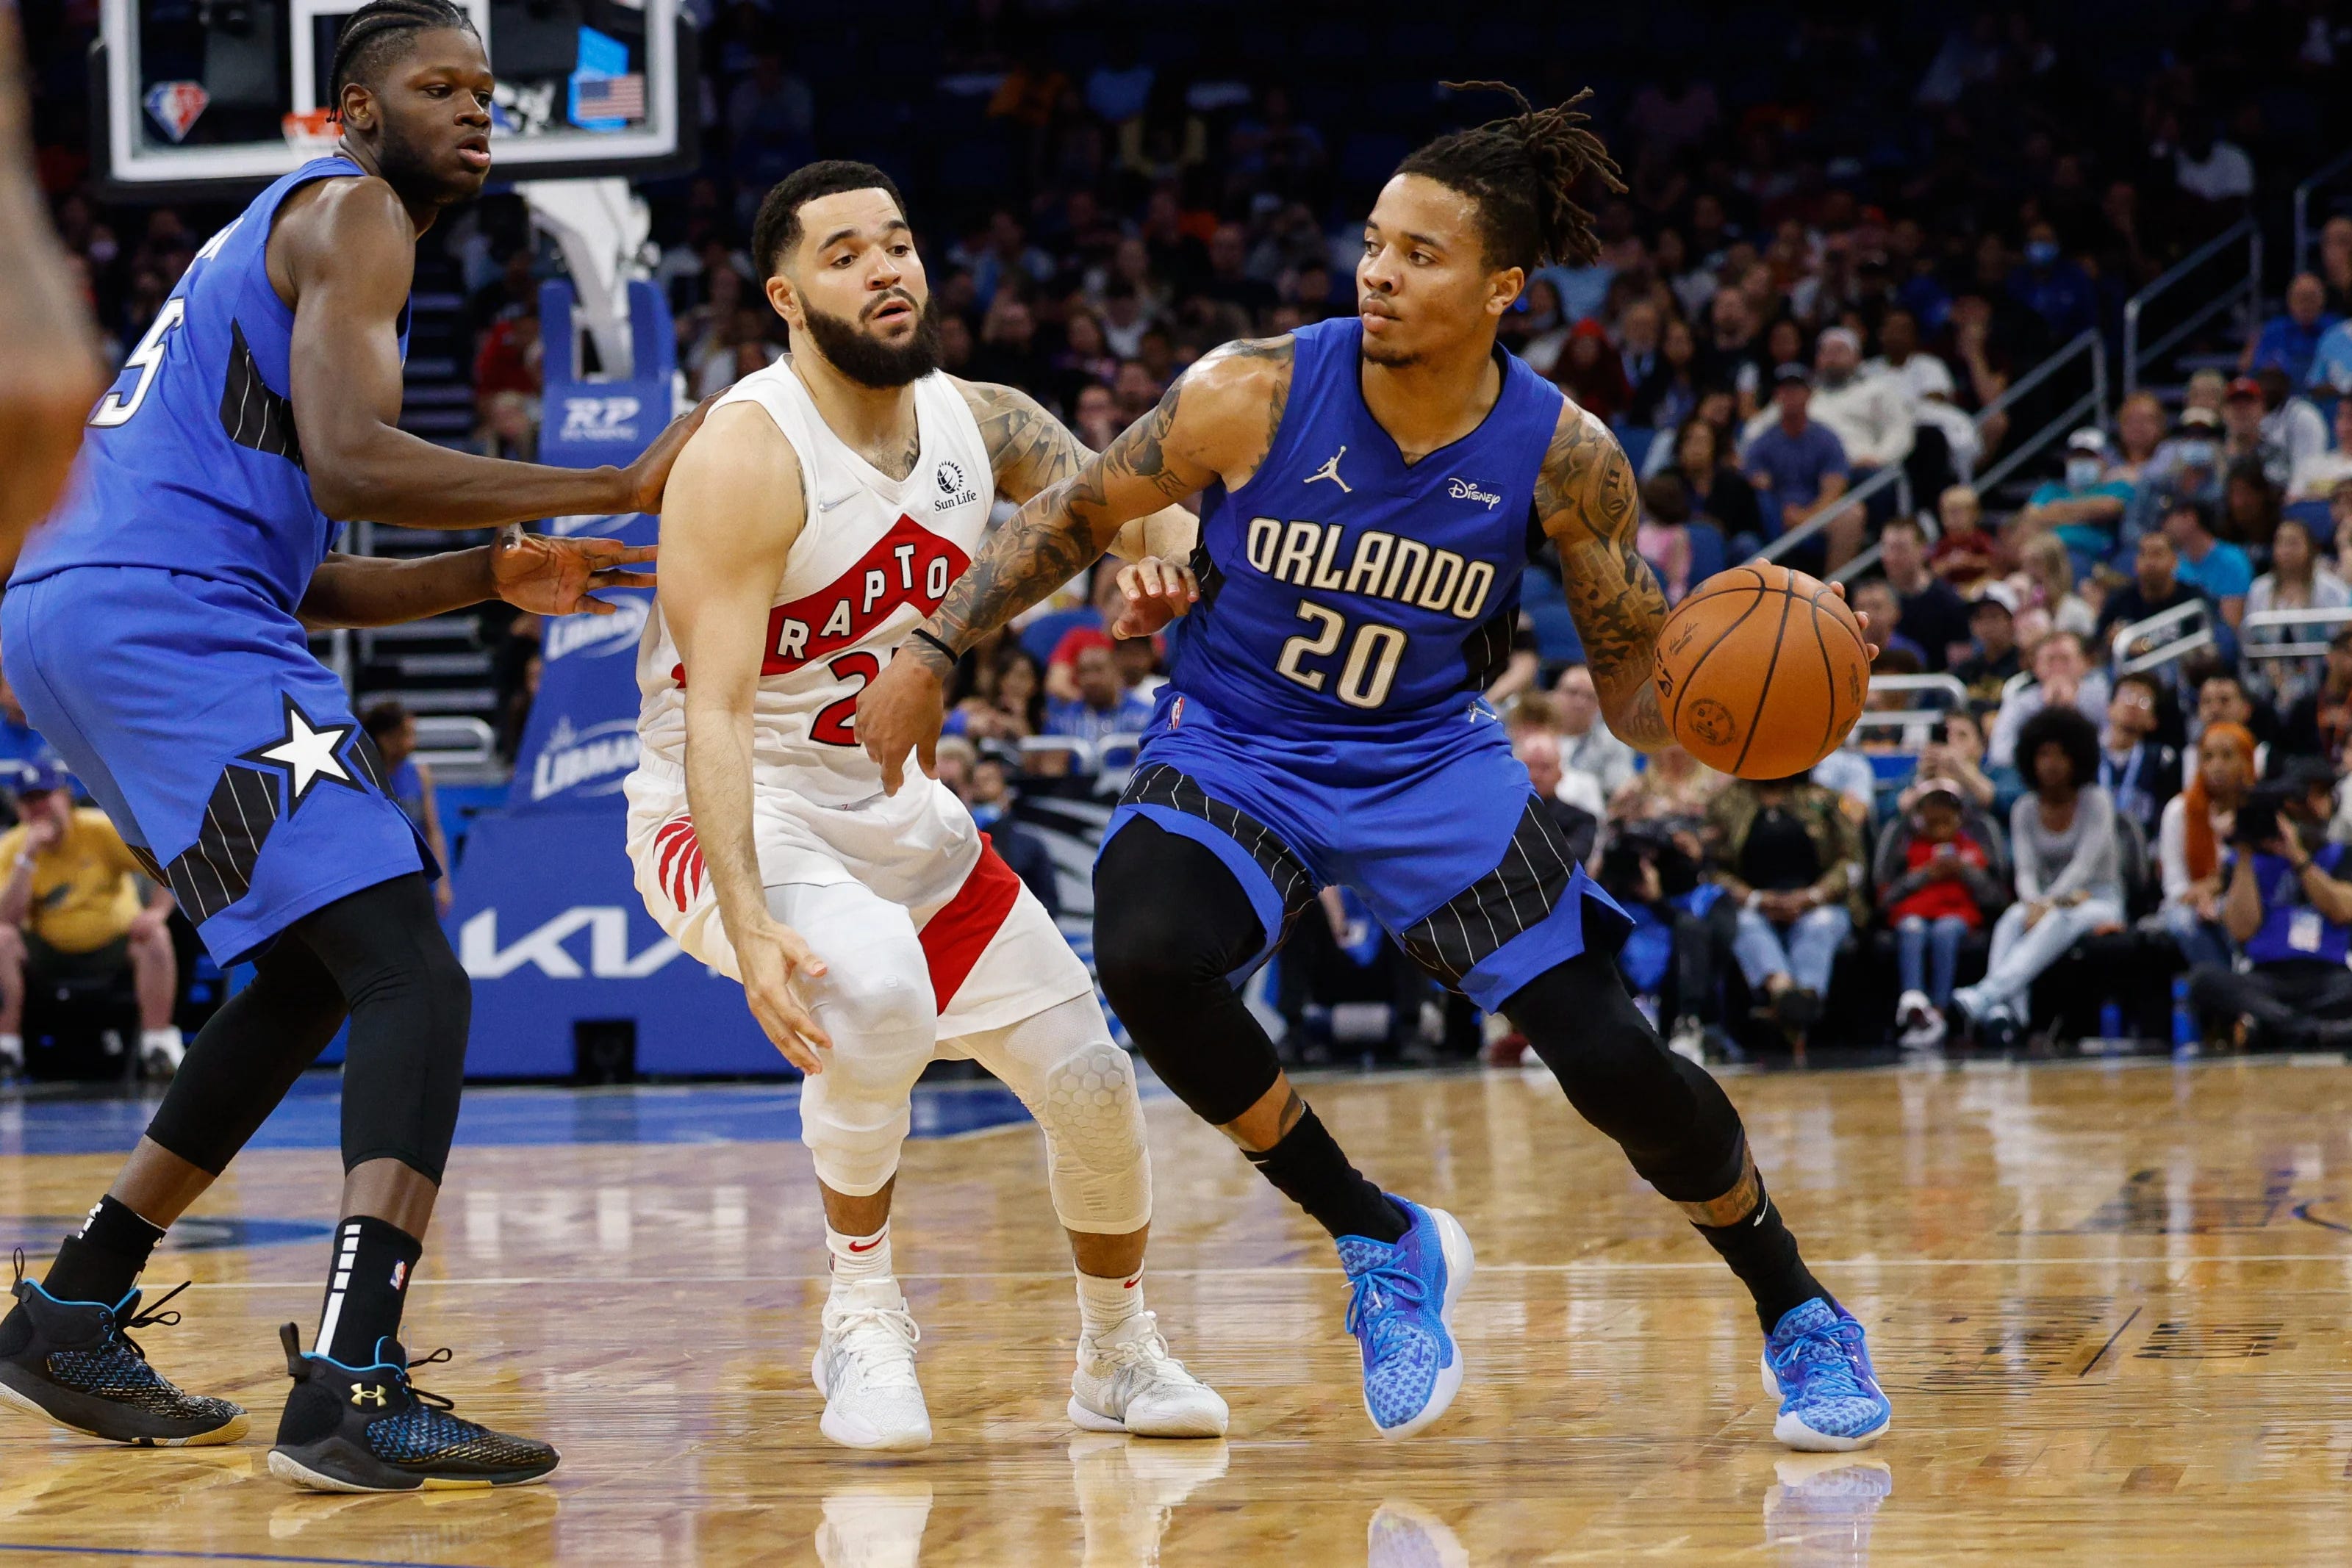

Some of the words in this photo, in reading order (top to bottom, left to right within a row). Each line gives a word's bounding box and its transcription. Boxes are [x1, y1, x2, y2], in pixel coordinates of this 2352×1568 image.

[87, 295, 184, 428] 5
[565, 397, 640, 428] RP
[934, 500, 956, 512] Sun
[956, 489, 977, 505] Life
[776, 543, 950, 660] RAPTO
[1247, 516, 1496, 621] ORLANDO
[808, 647, 900, 747] 2
[1274, 599, 1408, 711] 20
